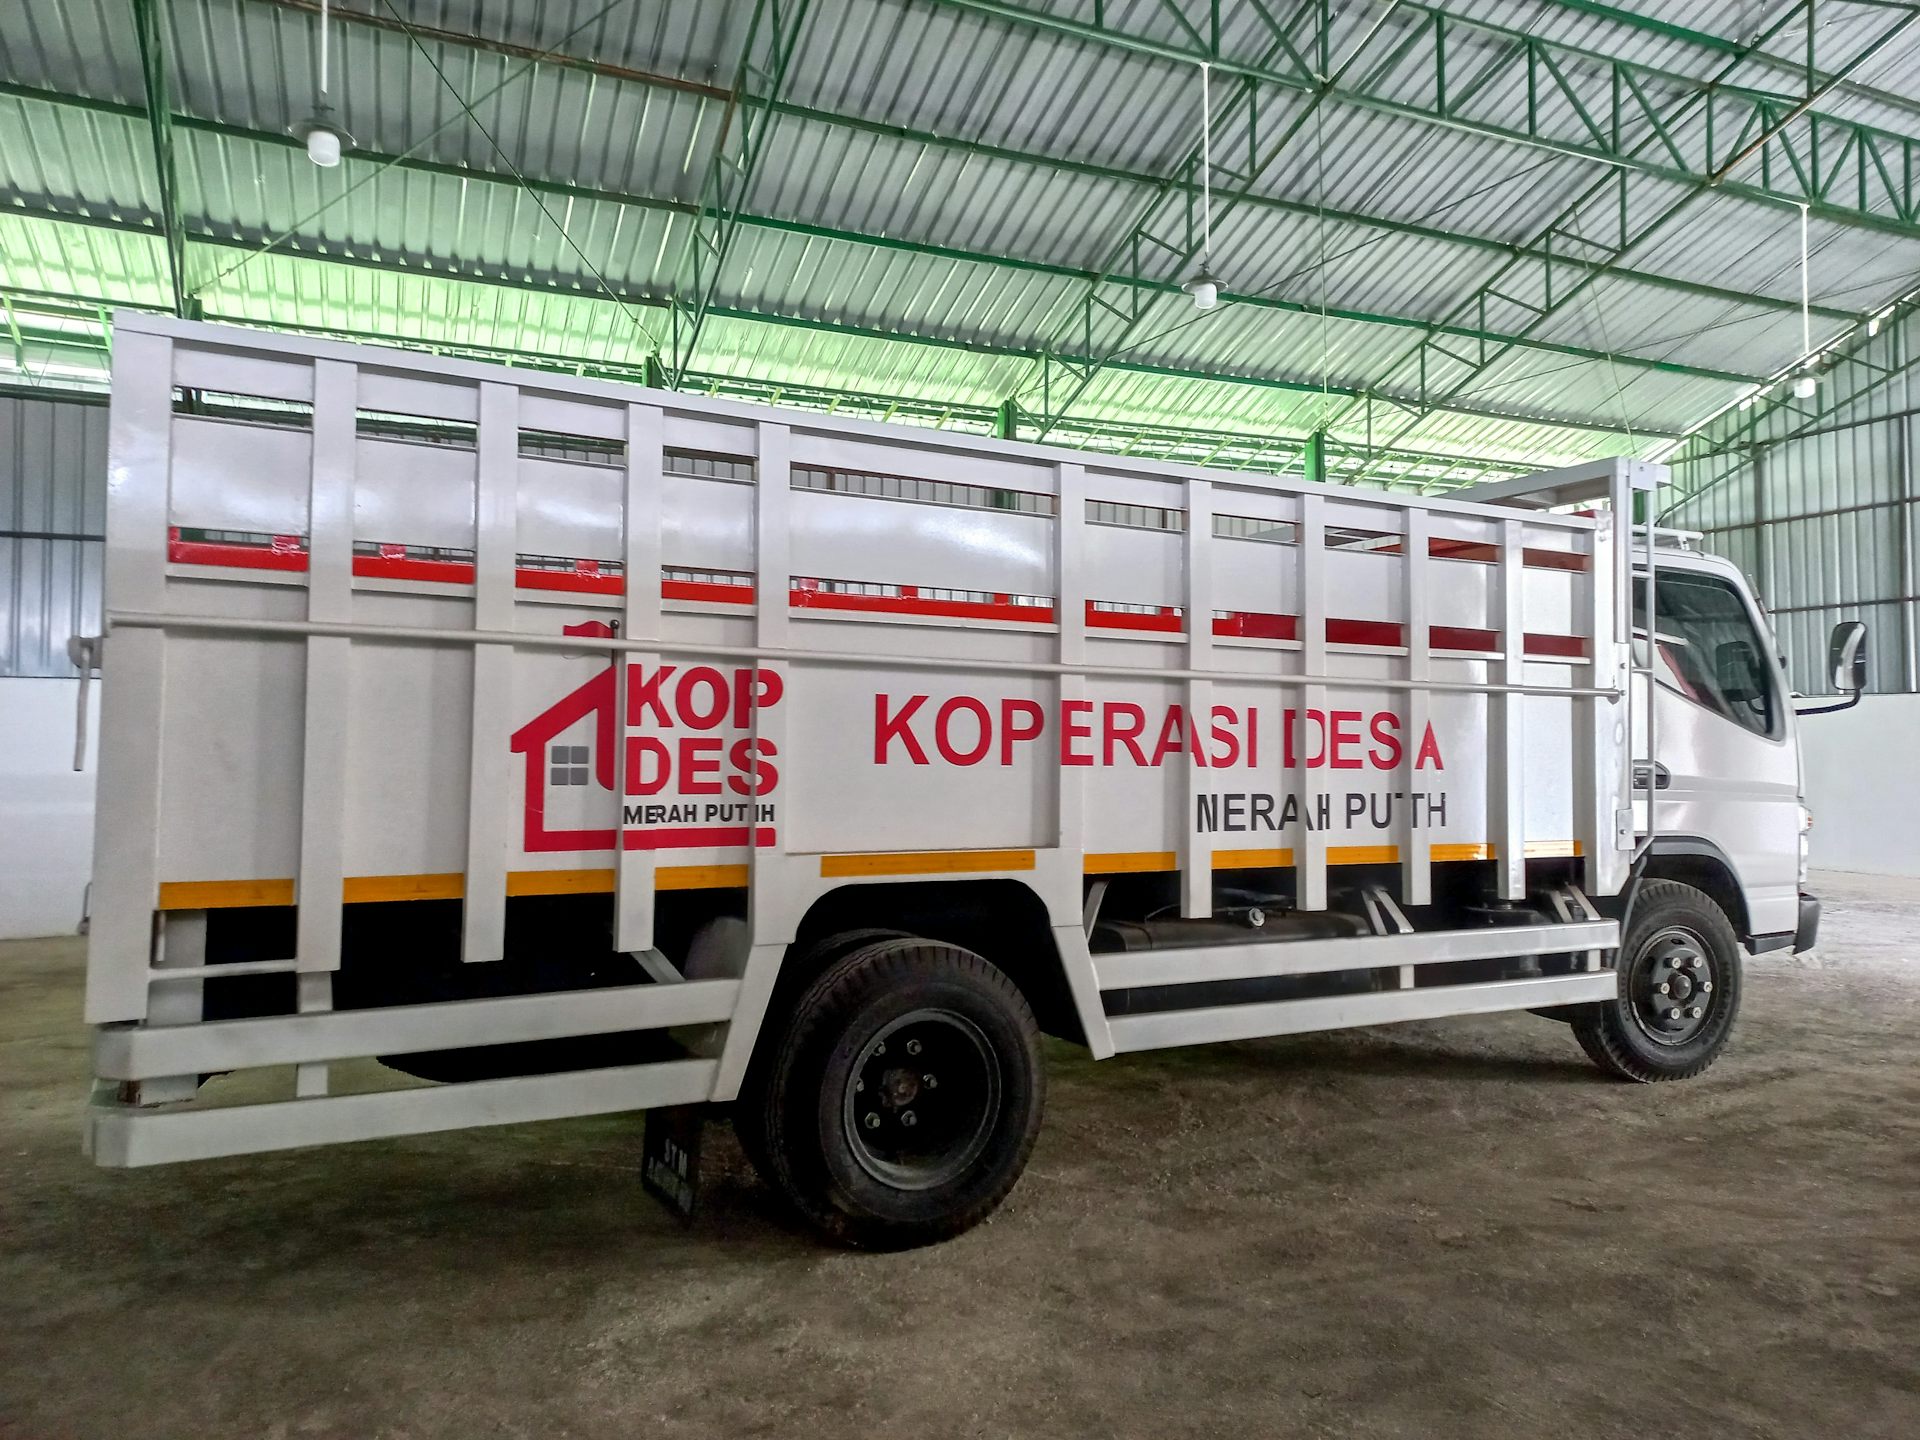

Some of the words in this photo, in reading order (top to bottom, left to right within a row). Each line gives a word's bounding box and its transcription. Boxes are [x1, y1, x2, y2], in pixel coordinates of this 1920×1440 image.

[626, 663, 784, 731] KOP
[873, 693, 1258, 769] KOPERASI
[1283, 709, 1445, 771] DESA
[625, 736, 779, 796] DES
[623, 803, 698, 825] MERAH
